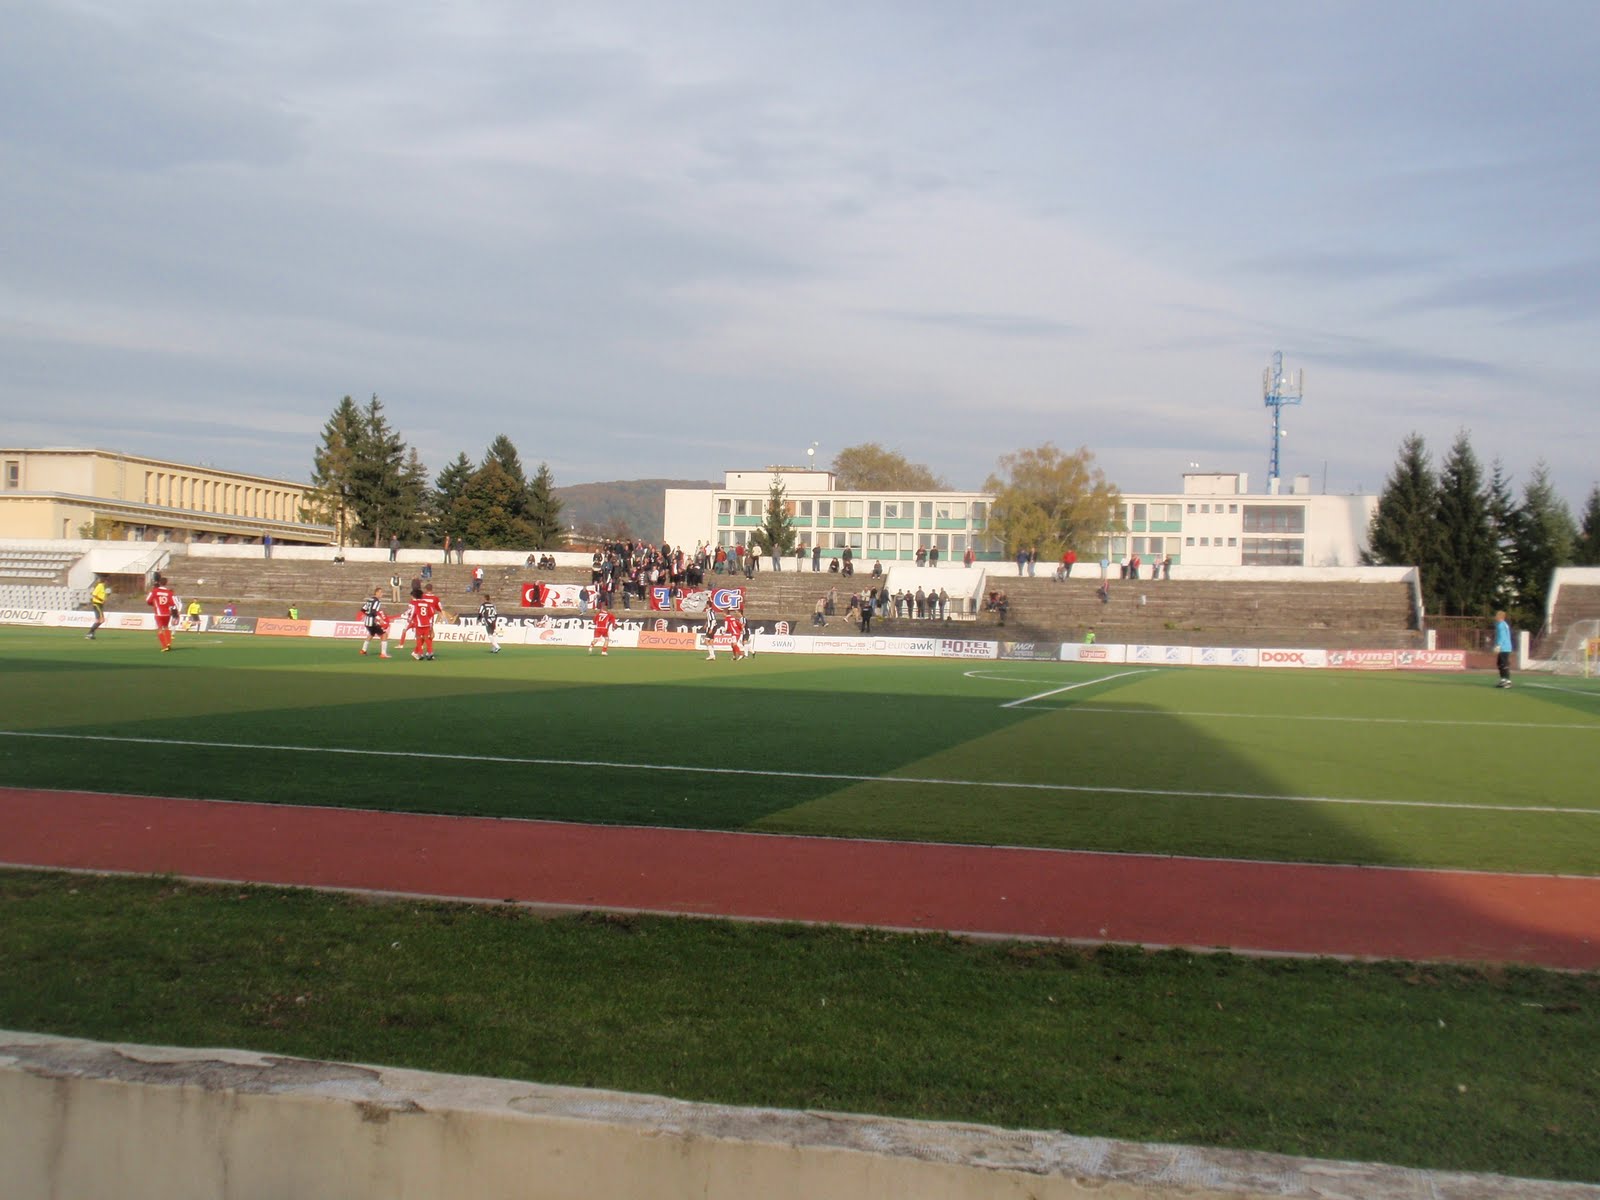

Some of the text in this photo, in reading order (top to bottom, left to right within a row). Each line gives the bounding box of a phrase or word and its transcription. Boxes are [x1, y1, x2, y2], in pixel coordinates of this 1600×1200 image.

[420, 606, 427, 616] 8
[437, 631, 487, 642] TRENČÍN
[648, 636, 696, 645] GIVOVA
[771, 640, 793, 648] SWAN
[888, 641, 933, 651] euroawk
[942, 640, 991, 653] HOTEL
[1261, 651, 1305, 664] DOXX
[1344, 650, 1394, 664] kyma
[1414, 650, 1465, 665] kyma
